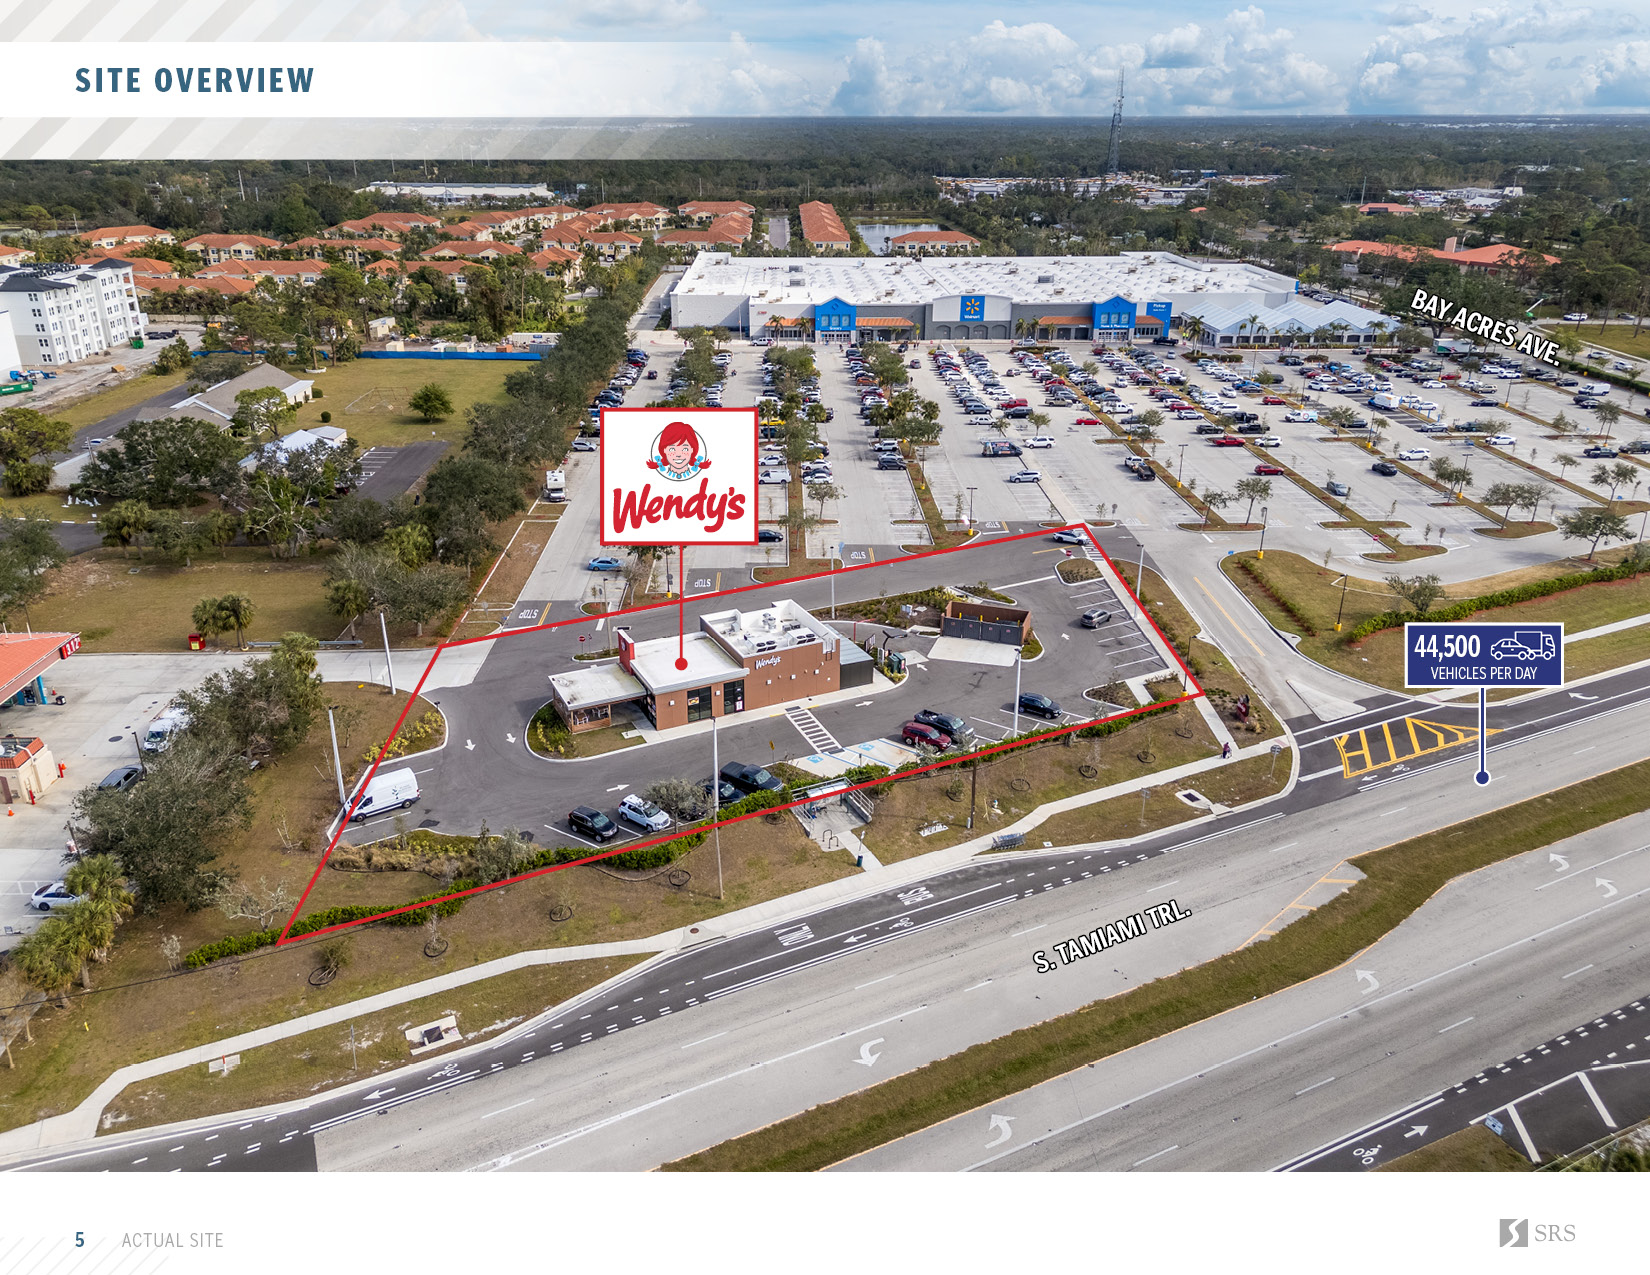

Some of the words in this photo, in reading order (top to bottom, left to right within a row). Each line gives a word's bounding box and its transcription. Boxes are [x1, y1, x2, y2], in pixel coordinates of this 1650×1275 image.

[850, 551, 867, 560] STOP
[694, 578, 712, 588] STOP
[519, 609, 539, 619] STOP
[773, 922, 815, 947] ONLY
